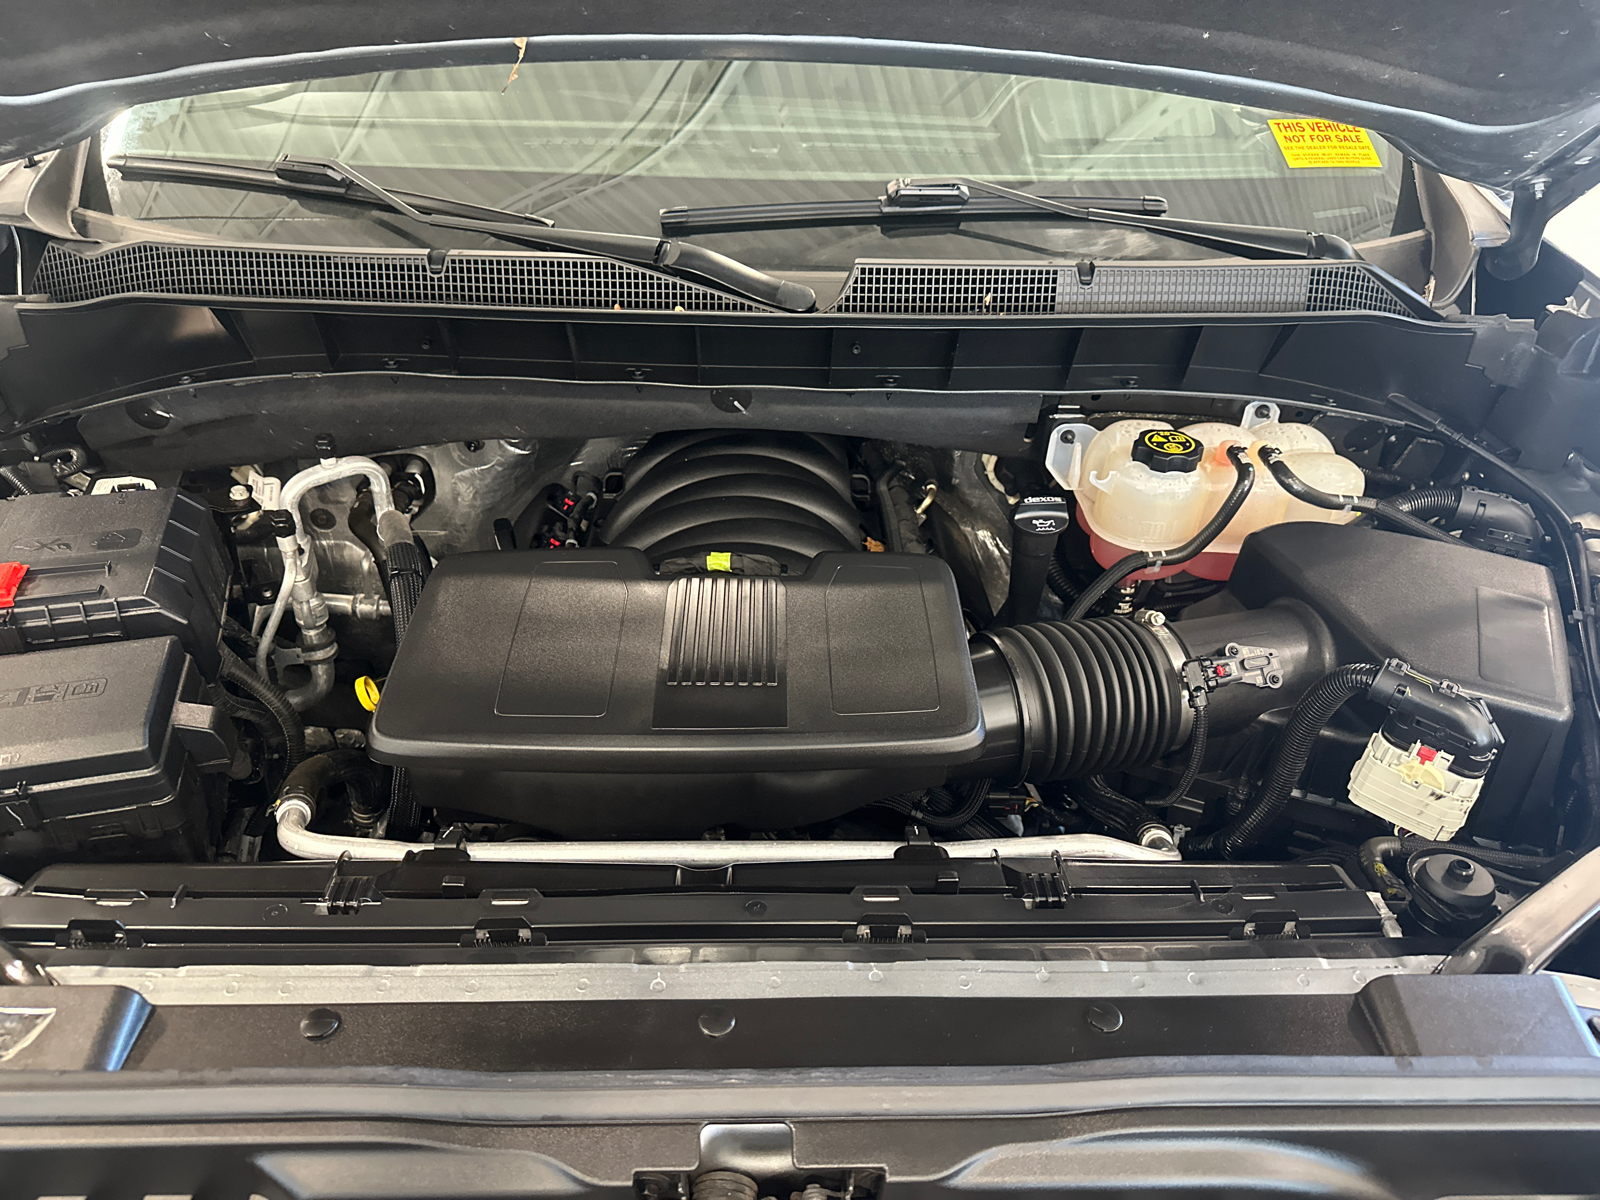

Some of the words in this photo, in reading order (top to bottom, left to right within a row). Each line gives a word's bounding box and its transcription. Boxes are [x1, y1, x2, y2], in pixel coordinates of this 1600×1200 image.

[1273, 122, 1306, 133] THIS
[1306, 122, 1361, 133] VEHICLE
[1283, 135, 1306, 143] NOT
[1309, 135, 1333, 143] FOR
[1334, 135, 1363, 143] SALE
